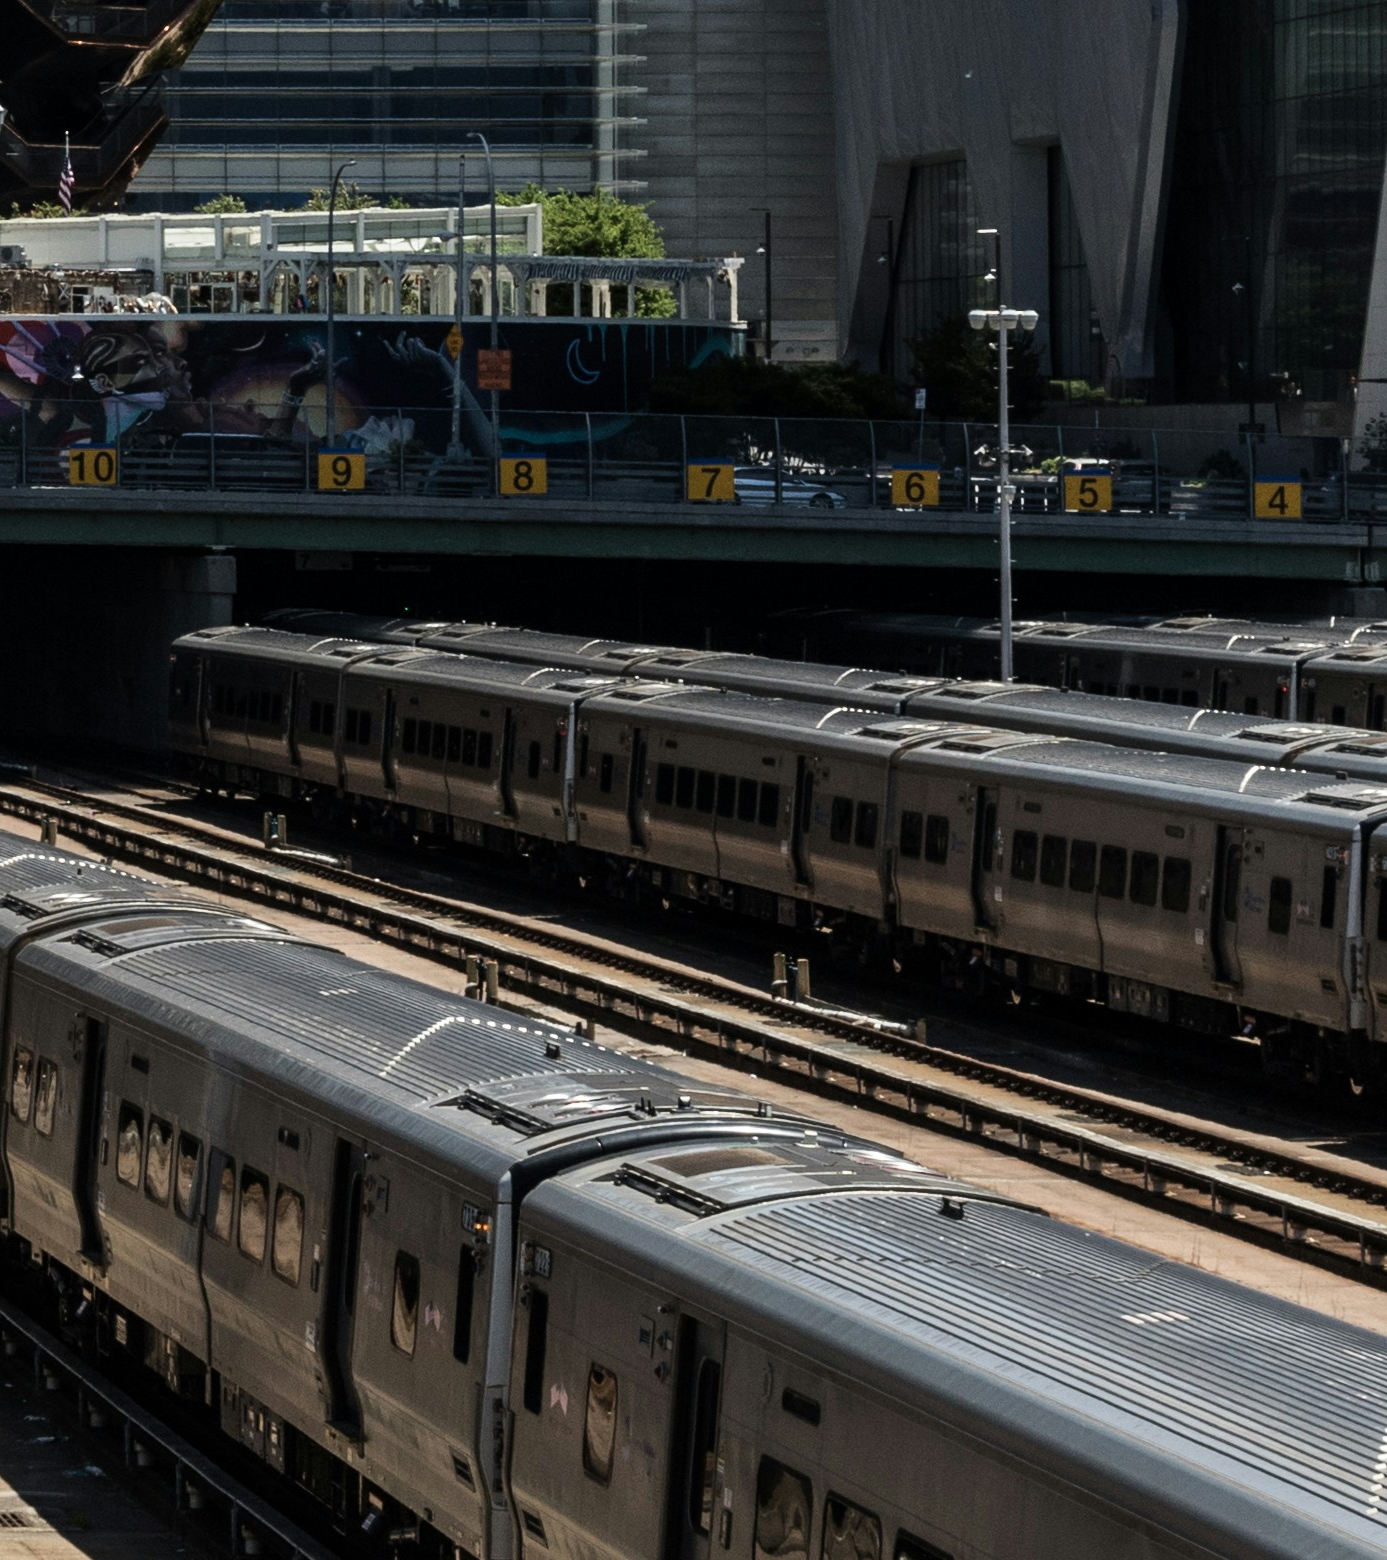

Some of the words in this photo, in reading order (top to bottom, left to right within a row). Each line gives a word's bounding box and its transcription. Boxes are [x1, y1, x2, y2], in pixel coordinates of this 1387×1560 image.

[71, 451, 114, 482] 10
[331, 456, 352, 487] 9
[513, 460, 534, 492] 8
[701, 467, 721, 498] 7
[905, 472, 926, 503] 6
[1079, 478, 1099, 508] 5
[1268, 485, 1289, 515] 4
